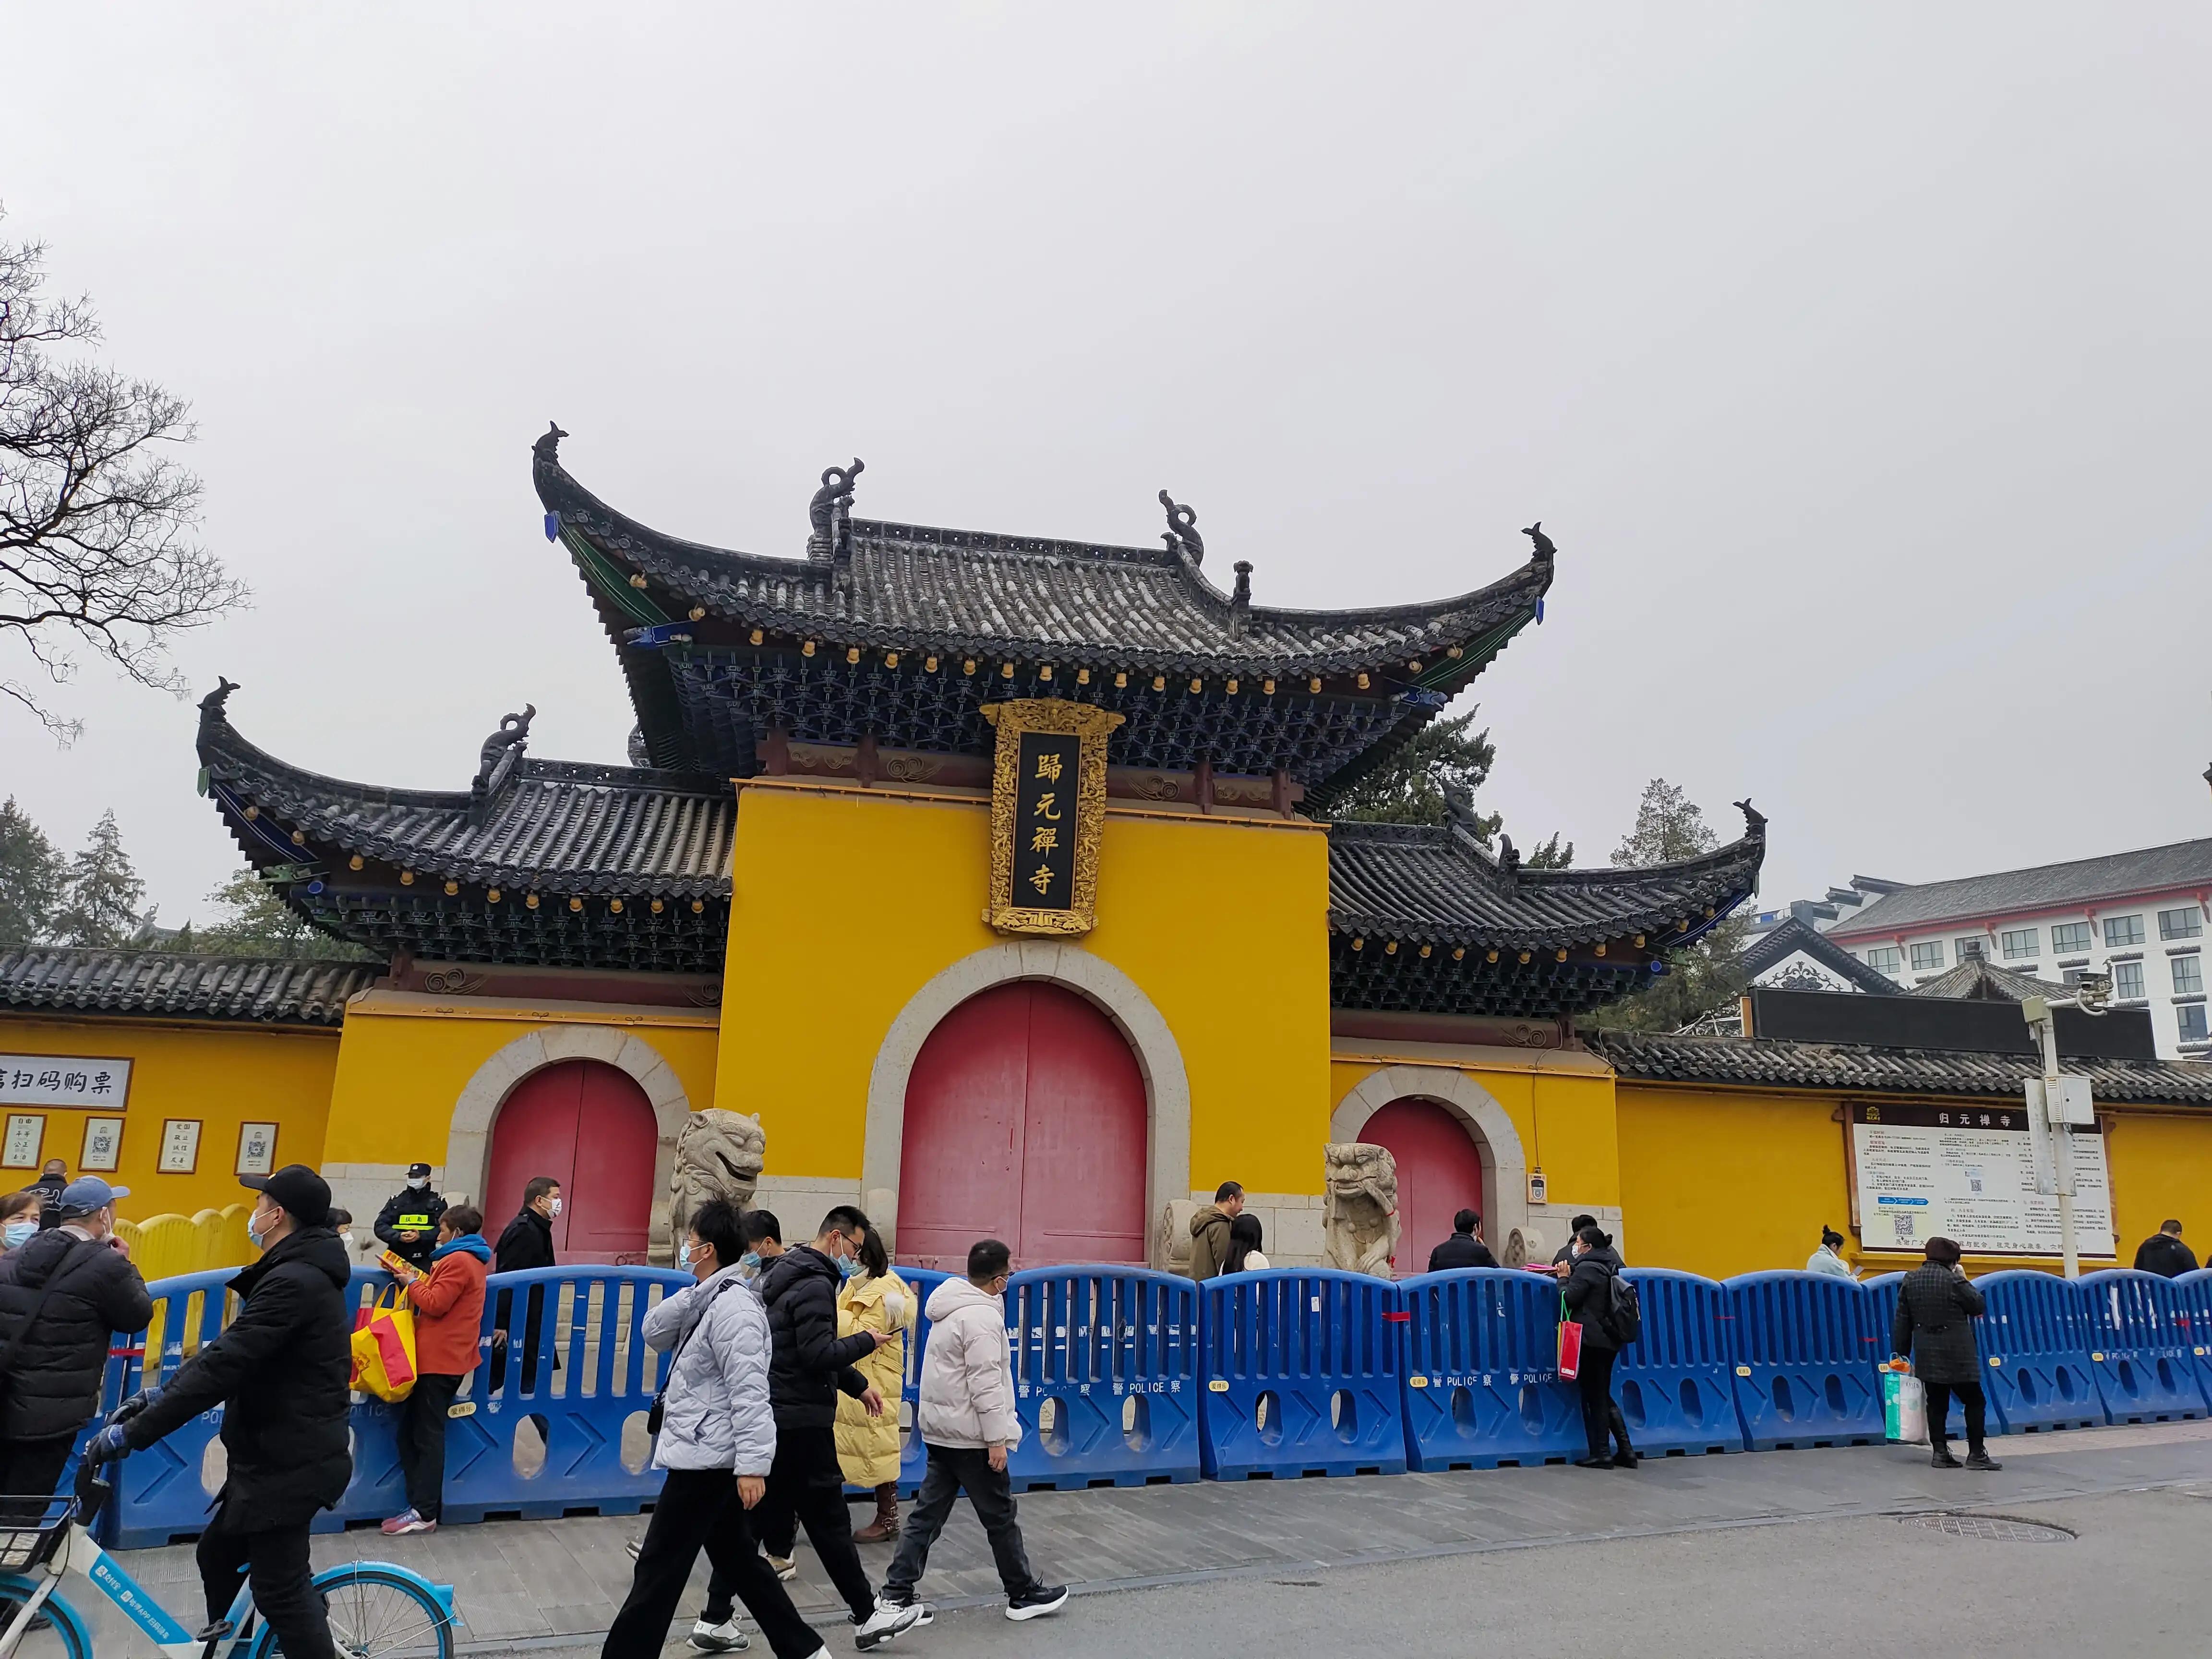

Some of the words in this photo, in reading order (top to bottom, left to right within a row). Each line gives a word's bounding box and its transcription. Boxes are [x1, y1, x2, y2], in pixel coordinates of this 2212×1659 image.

[1029, 753, 1063, 895] 歸元禪寺
[1939, 1112, 2010, 1127] 归元禅寺
[1447, 1376, 1477, 1386] POLICE
[1524, 1374, 1553, 1383] POLICE
[1018, 1384, 1030, 1398] 警
[1113, 1382, 1123, 1395] 警
[1129, 1382, 1164, 1394] POLICE
[1171, 1380, 1180, 1393] 察
